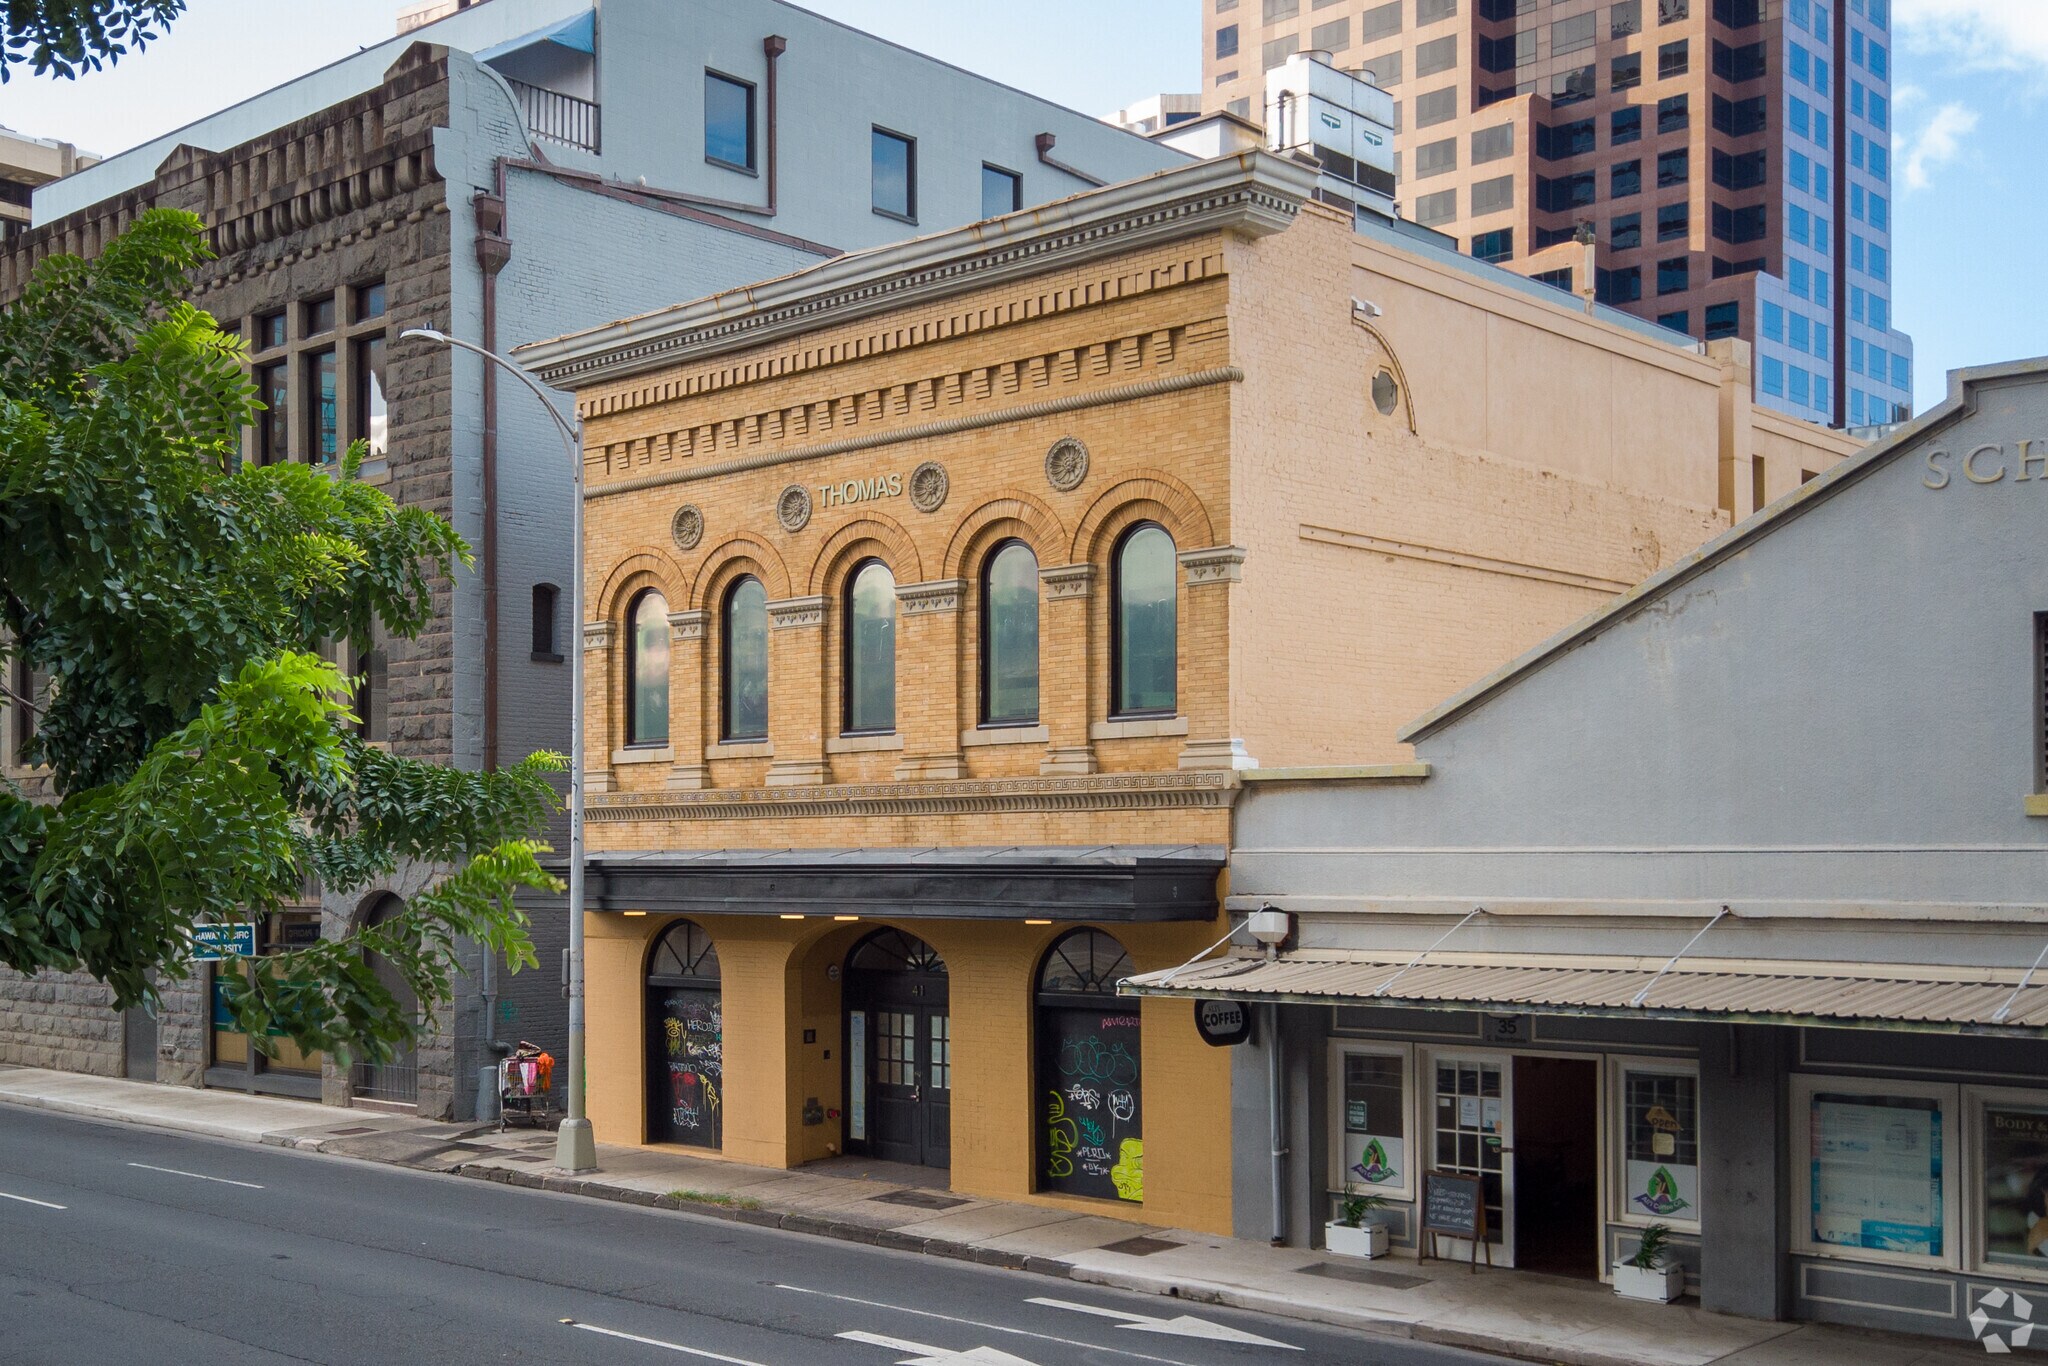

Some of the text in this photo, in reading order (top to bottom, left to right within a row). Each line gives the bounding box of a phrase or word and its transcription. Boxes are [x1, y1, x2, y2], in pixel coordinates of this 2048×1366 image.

[1922, 437, 2048, 490] SCH
[818, 472, 902, 507] THOMAS
[195, 930, 250, 941] HAWA PCIFIC
[202, 943, 243, 954] VERSITY
[911, 985, 924, 997] 41
[1203, 1010, 1241, 1027] COFFEE
[1498, 1019, 1517, 1034] 35
